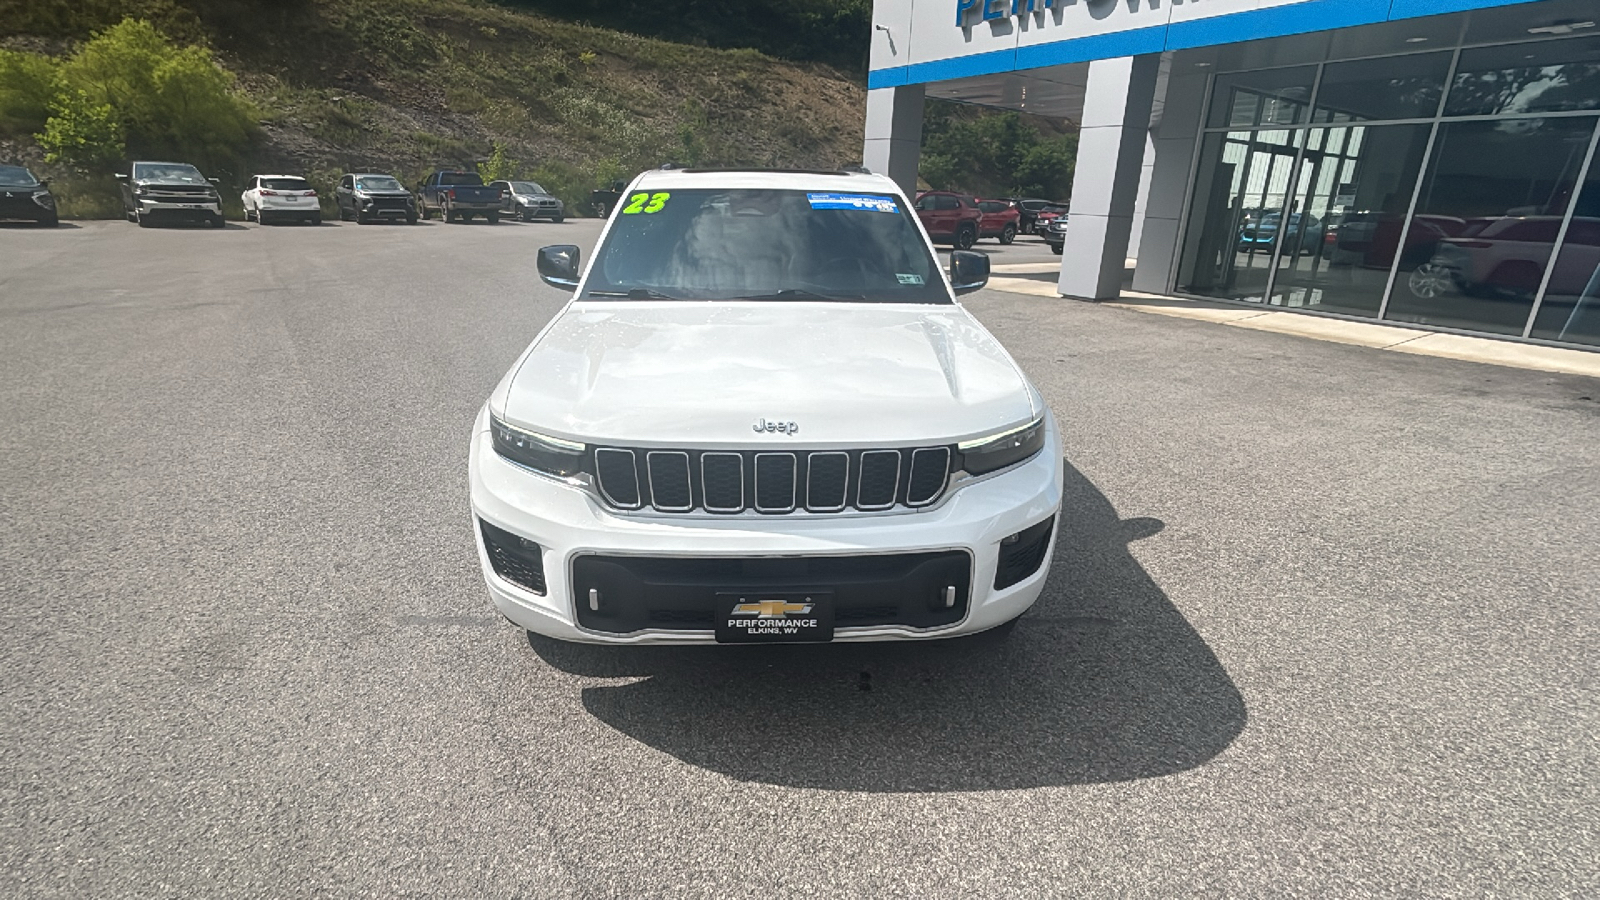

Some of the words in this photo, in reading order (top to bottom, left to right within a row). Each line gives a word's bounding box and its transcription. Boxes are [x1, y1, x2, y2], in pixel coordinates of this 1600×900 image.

[623, 192, 670, 214] 23
[753, 418, 799, 436] Jeep
[728, 619, 817, 627] PERFORMANCE
